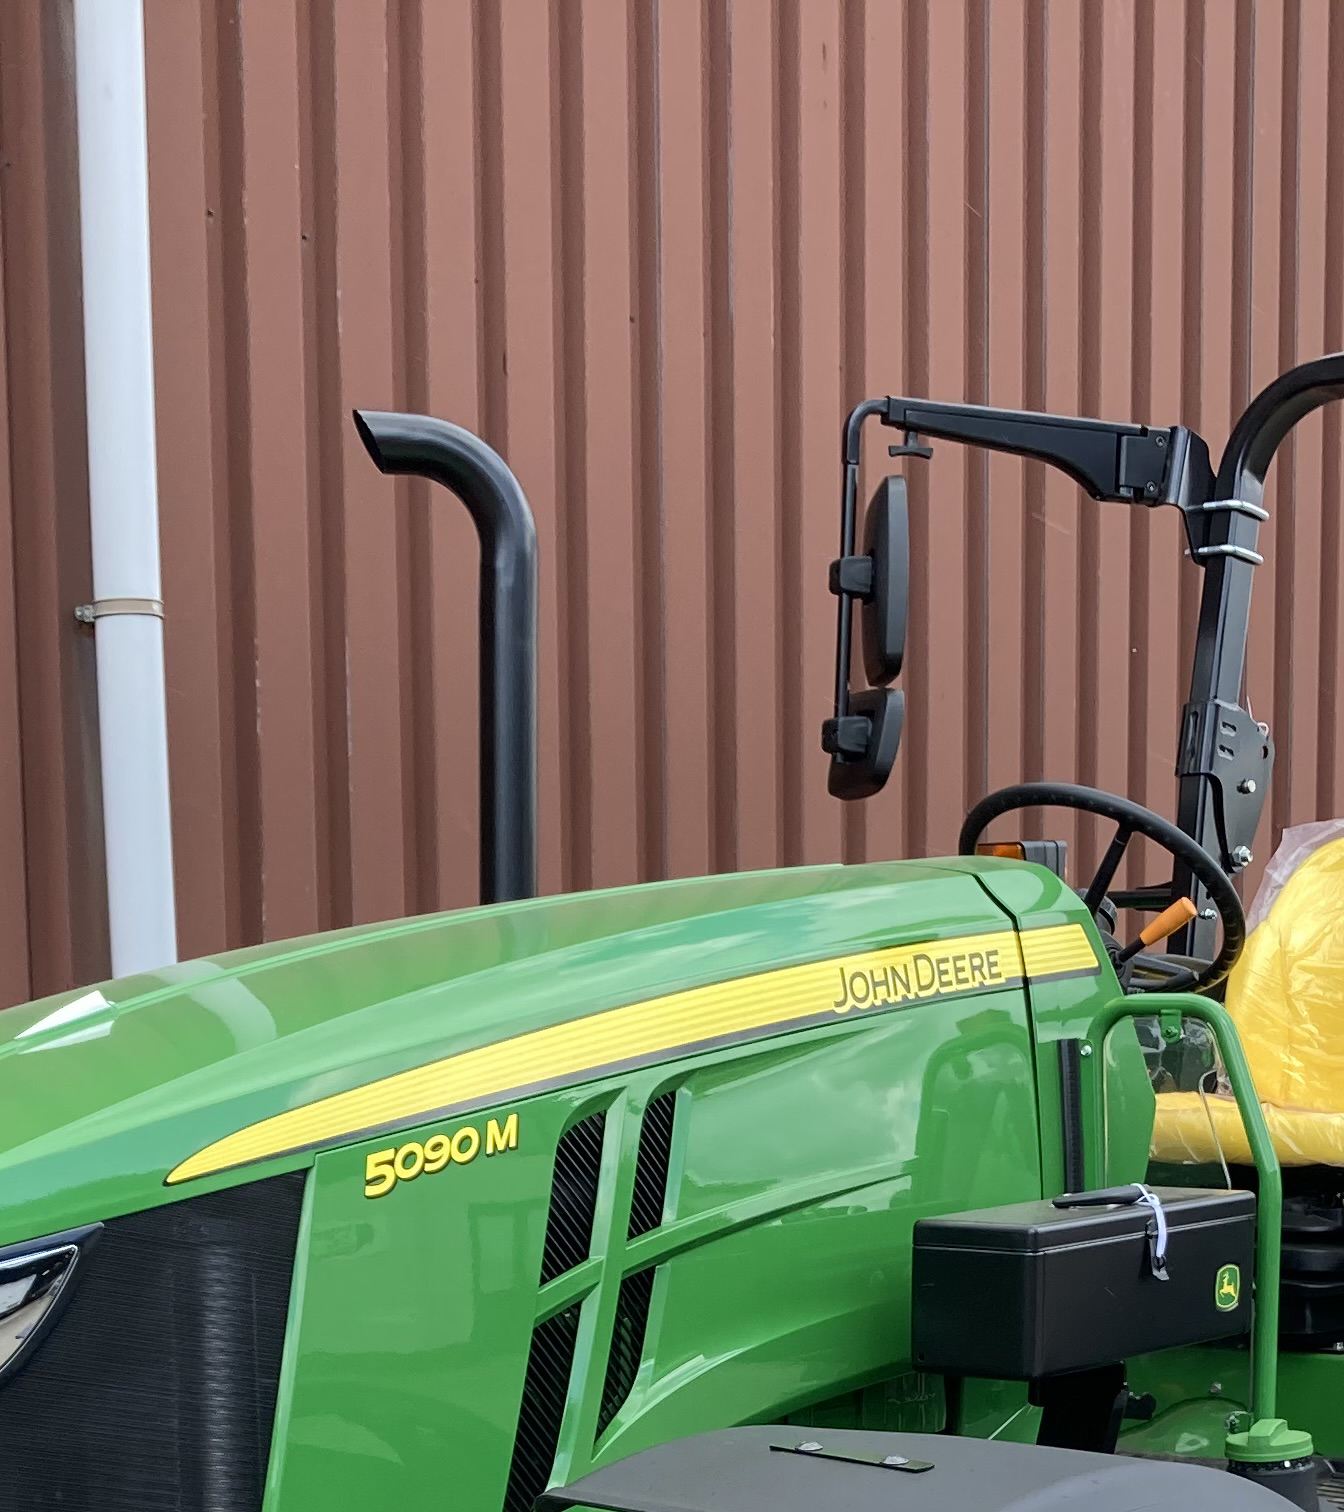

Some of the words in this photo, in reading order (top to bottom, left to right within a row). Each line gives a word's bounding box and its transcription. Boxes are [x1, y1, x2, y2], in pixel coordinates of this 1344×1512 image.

[833, 964, 912, 1009] JOHN
[912, 949, 1003, 993] DEERE
[363, 1126, 482, 1199] 5090
[485, 1113, 519, 1157] M
